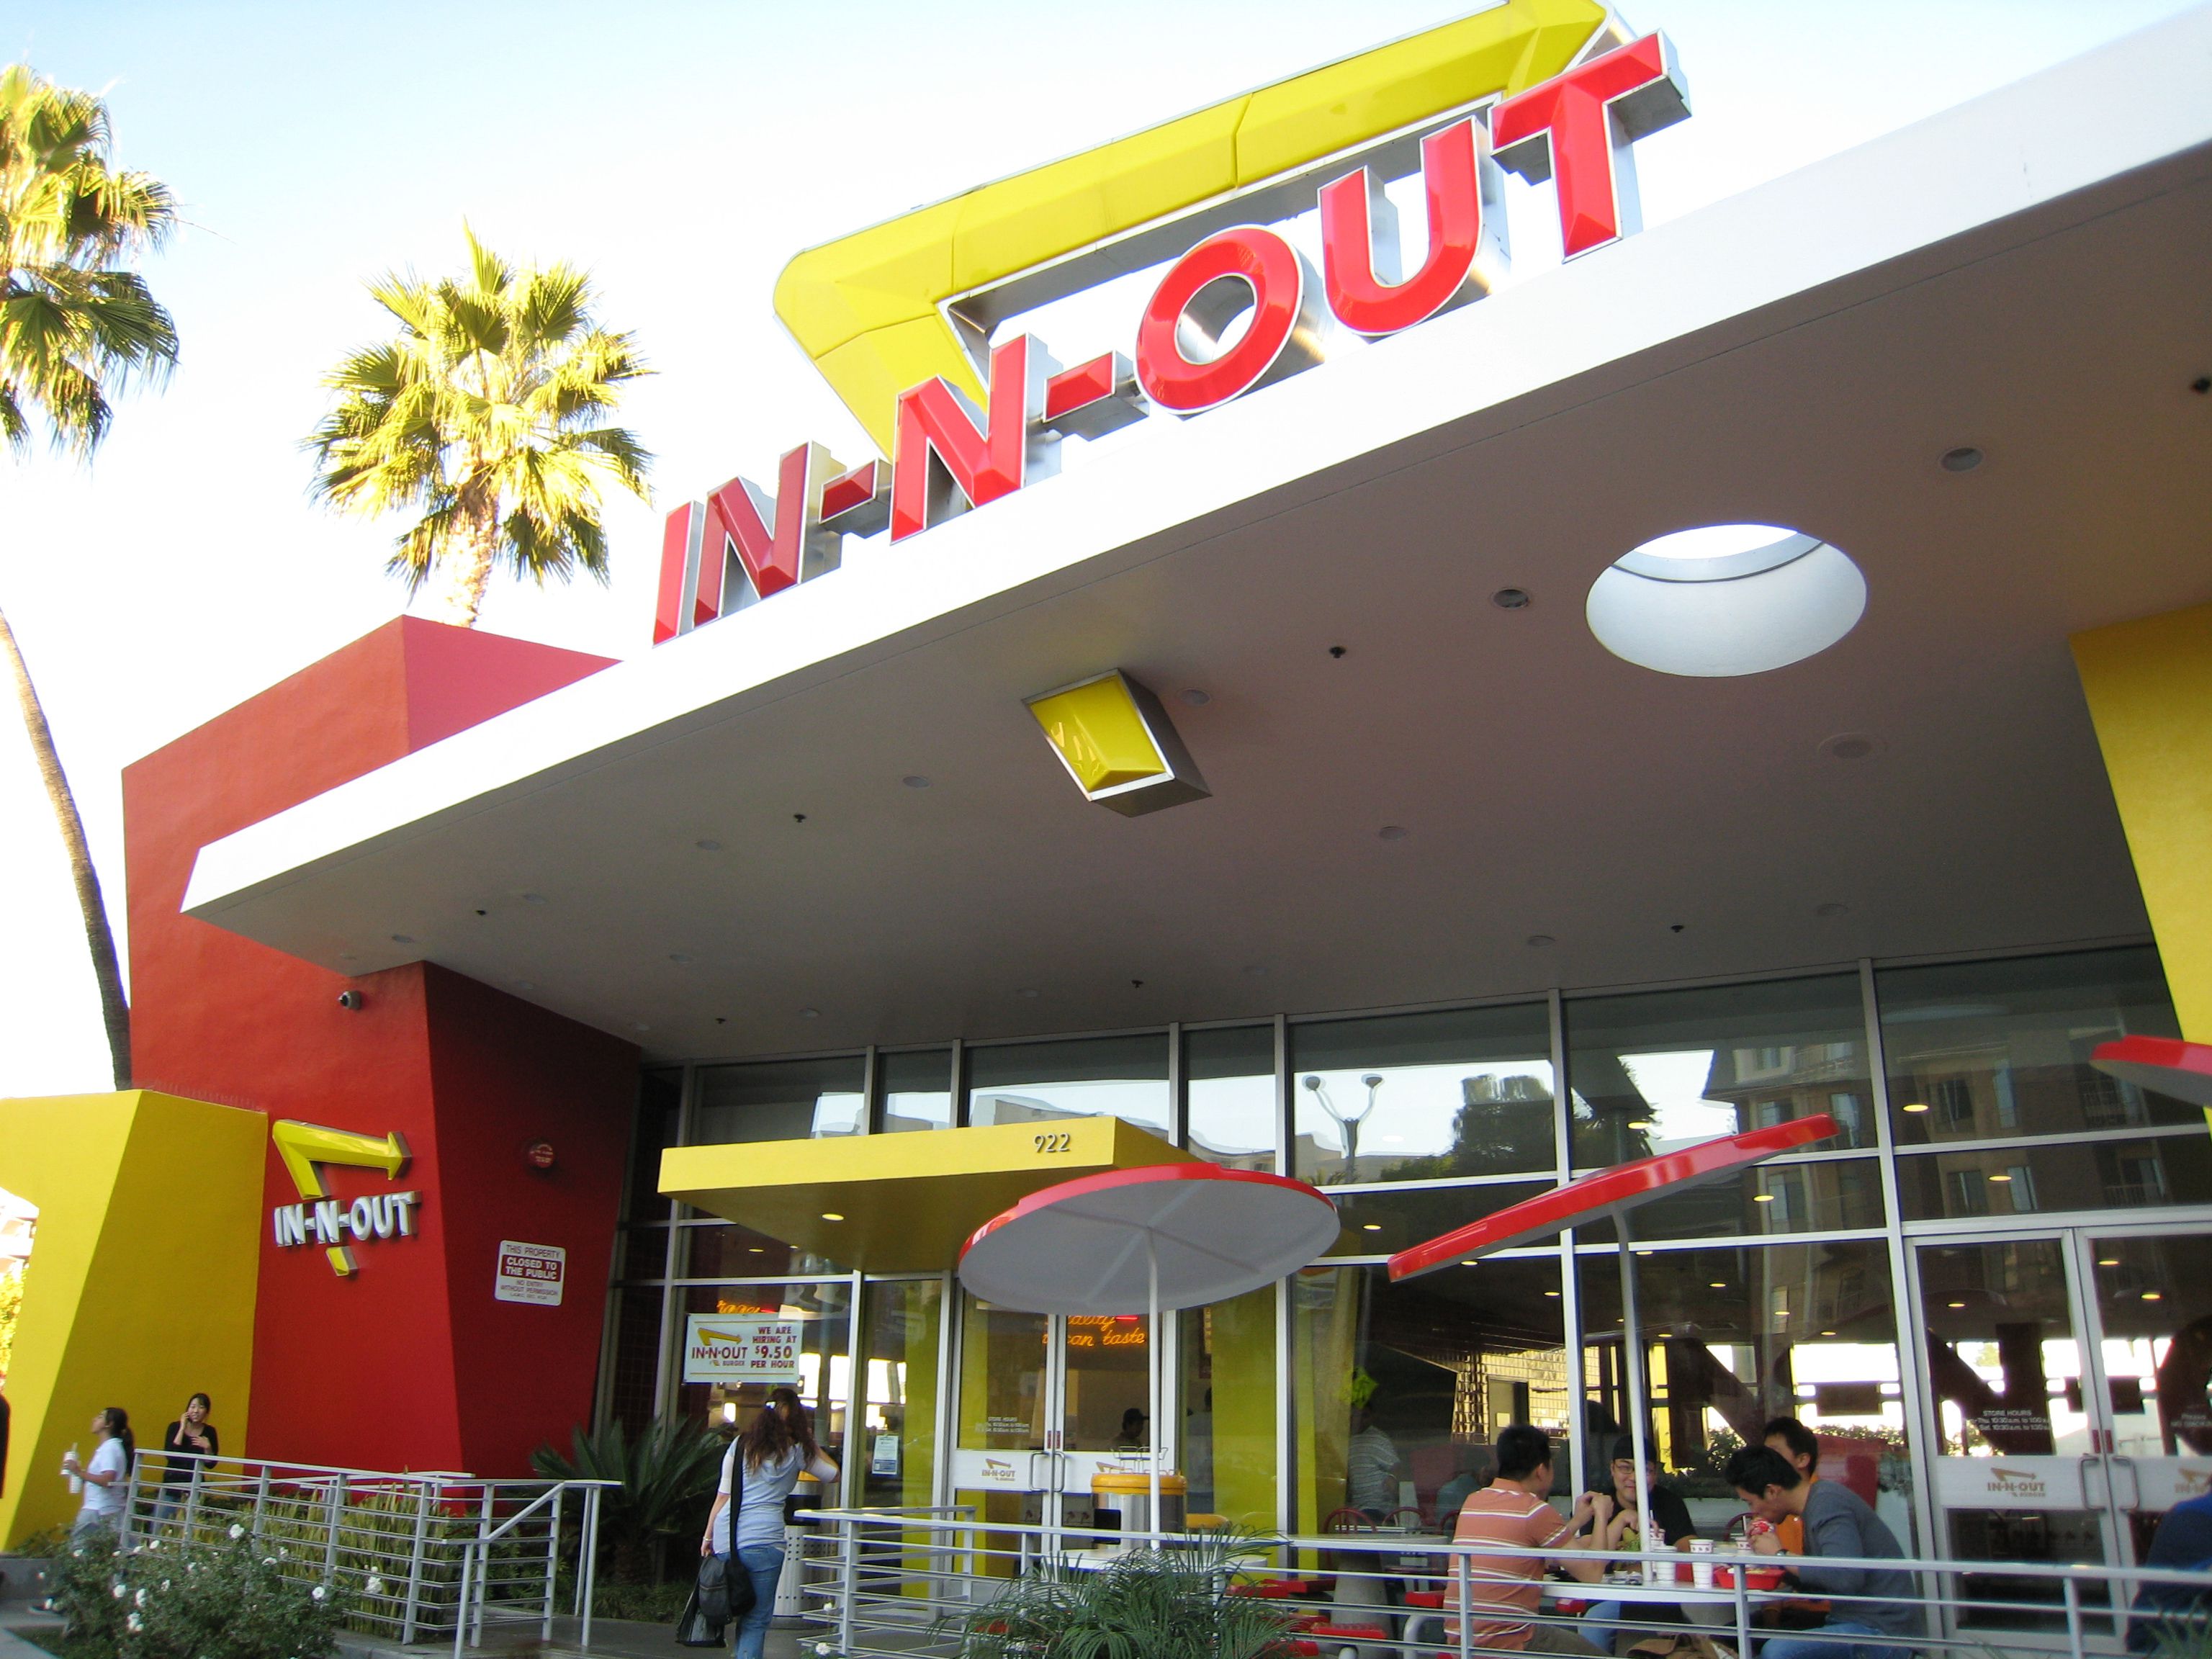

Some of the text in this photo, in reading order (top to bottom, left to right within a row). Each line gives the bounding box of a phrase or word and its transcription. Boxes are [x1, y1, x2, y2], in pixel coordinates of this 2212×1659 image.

[652, 27, 1674, 648] IN-N-OUT
[1033, 1133, 1071, 1153] 922
[274, 1190, 421, 1247] IN-N-OUT
[506, 1244, 560, 1259] THIS PROPERTY
[506, 1256, 557, 1271] CLOSED TO
[505, 1266, 557, 1280] THE PUBLIC
[786, 1335, 797, 1344] AT
[1102, 1328, 1146, 1345] taste
[755, 1345, 793, 1359] $9.50
[750, 1359, 795, 1368] PER HOUR
[1987, 1482, 2045, 1491] IN-N-OUT
